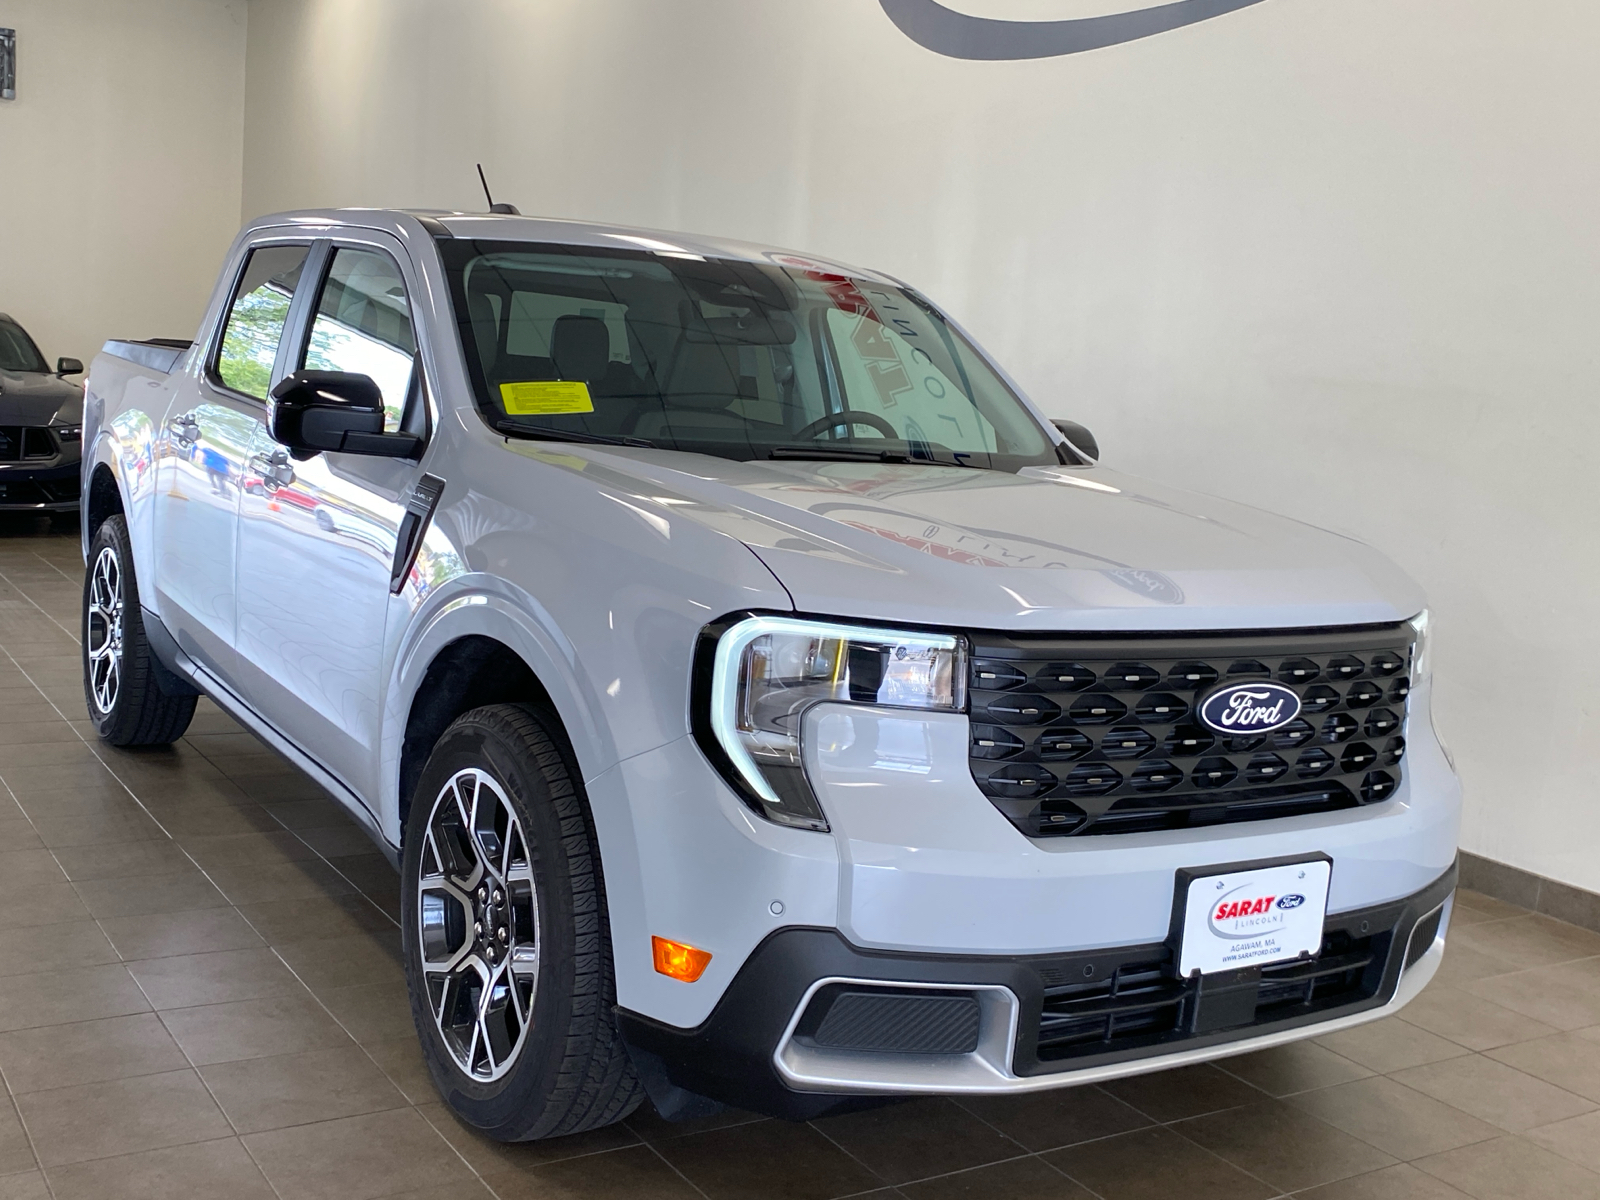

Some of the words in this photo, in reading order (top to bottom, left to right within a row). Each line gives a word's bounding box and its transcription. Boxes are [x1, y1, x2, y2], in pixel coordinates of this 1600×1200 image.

[1219, 690, 1285, 727] Ford
[1214, 895, 1276, 921] SARAT
[1279, 895, 1302, 908] Ford
[1240, 915, 1278, 928] LINCOLN
[1230, 940, 1263, 953] AGAWAM,
[1264, 938, 1276, 947] MA
[1222, 946, 1281, 962] WWW.SARATFORD.COM
